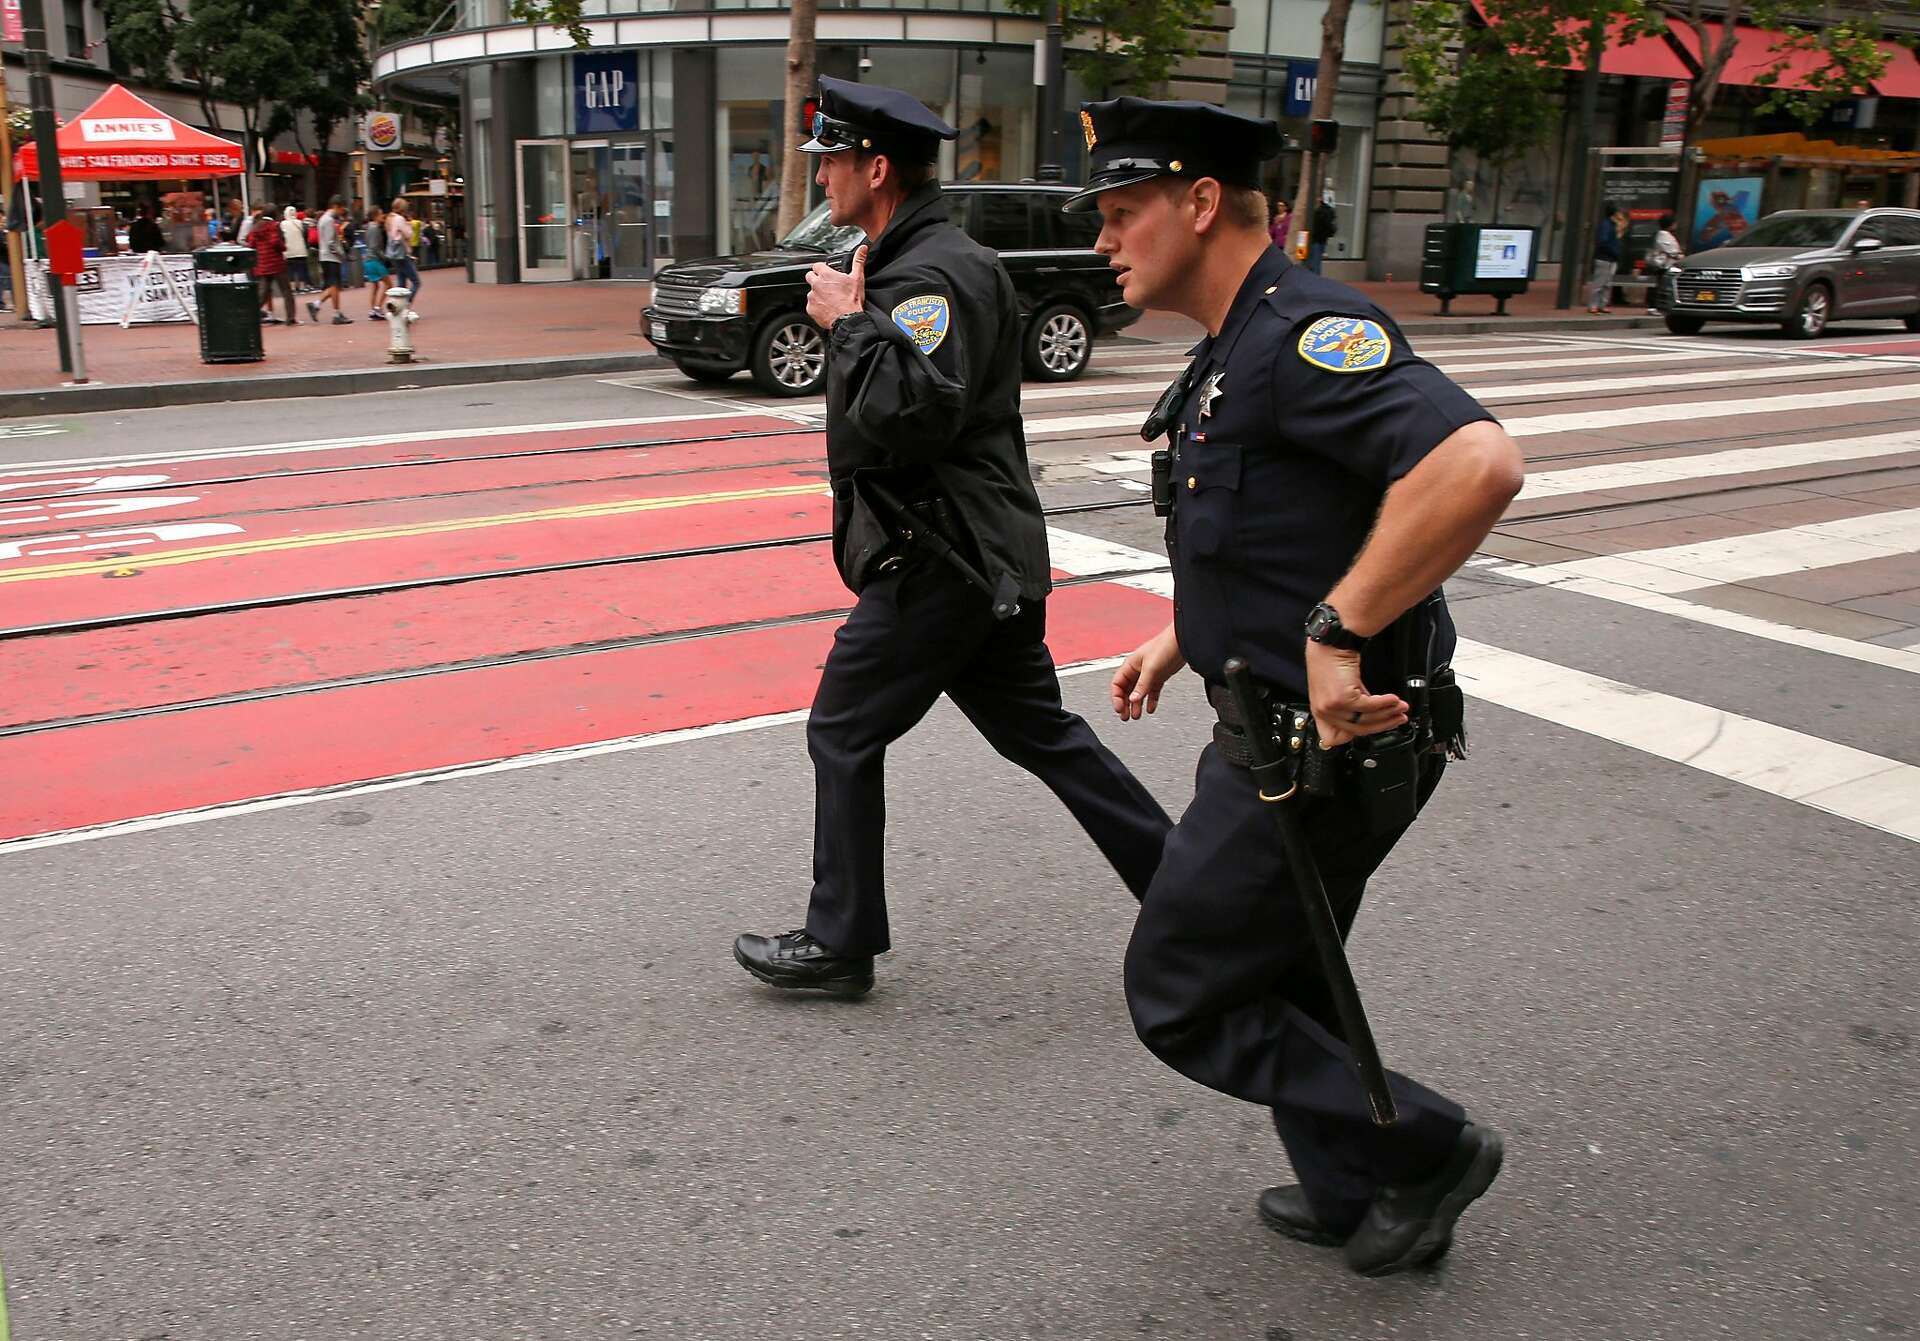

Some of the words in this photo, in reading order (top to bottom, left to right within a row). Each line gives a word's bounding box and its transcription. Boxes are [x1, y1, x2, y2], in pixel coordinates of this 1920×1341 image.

[585, 70, 624, 109] GAP
[92, 122, 164, 134] ANNIE'S
[169, 154, 201, 167] SINCE
[909, 297, 943, 307] FRANCISCO
[908, 306, 932, 316] POLICE
